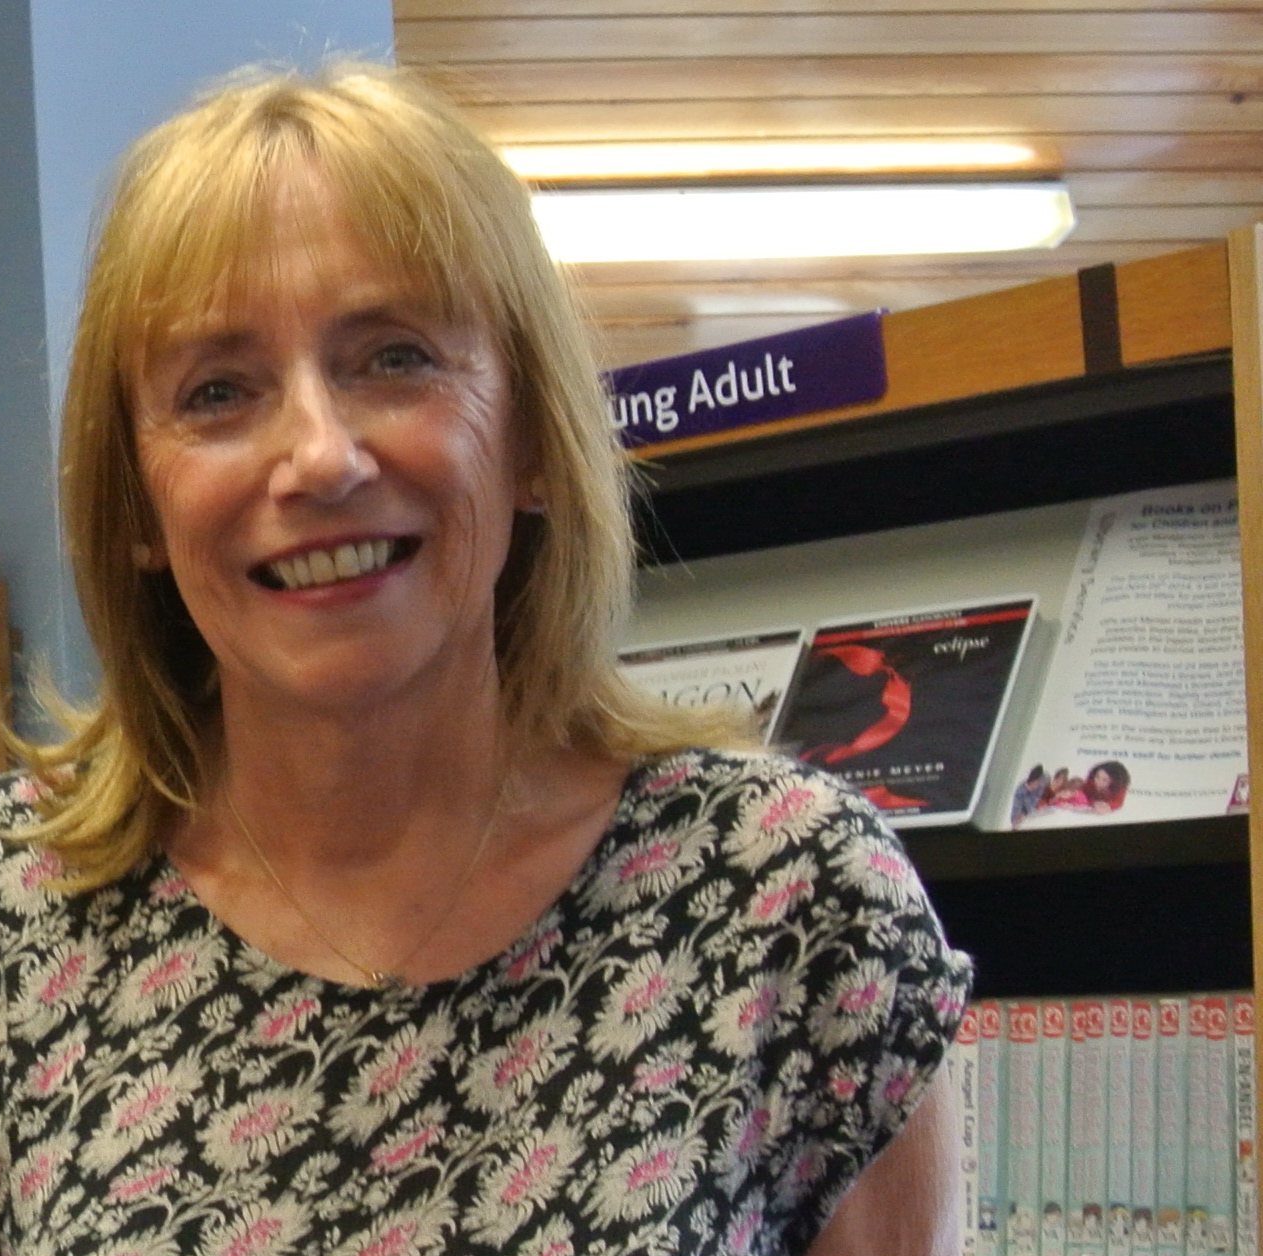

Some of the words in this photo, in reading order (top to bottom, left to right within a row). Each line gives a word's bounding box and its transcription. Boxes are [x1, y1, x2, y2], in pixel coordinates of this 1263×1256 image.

[608, 386, 680, 432] ung
[689, 352, 797, 413] Adult
[933, 636, 989, 662] eclipse
[889, 762, 945, 775] MEYER
[961, 1058, 975, 1110] Angel
[962, 1115, 976, 1148] Cup
